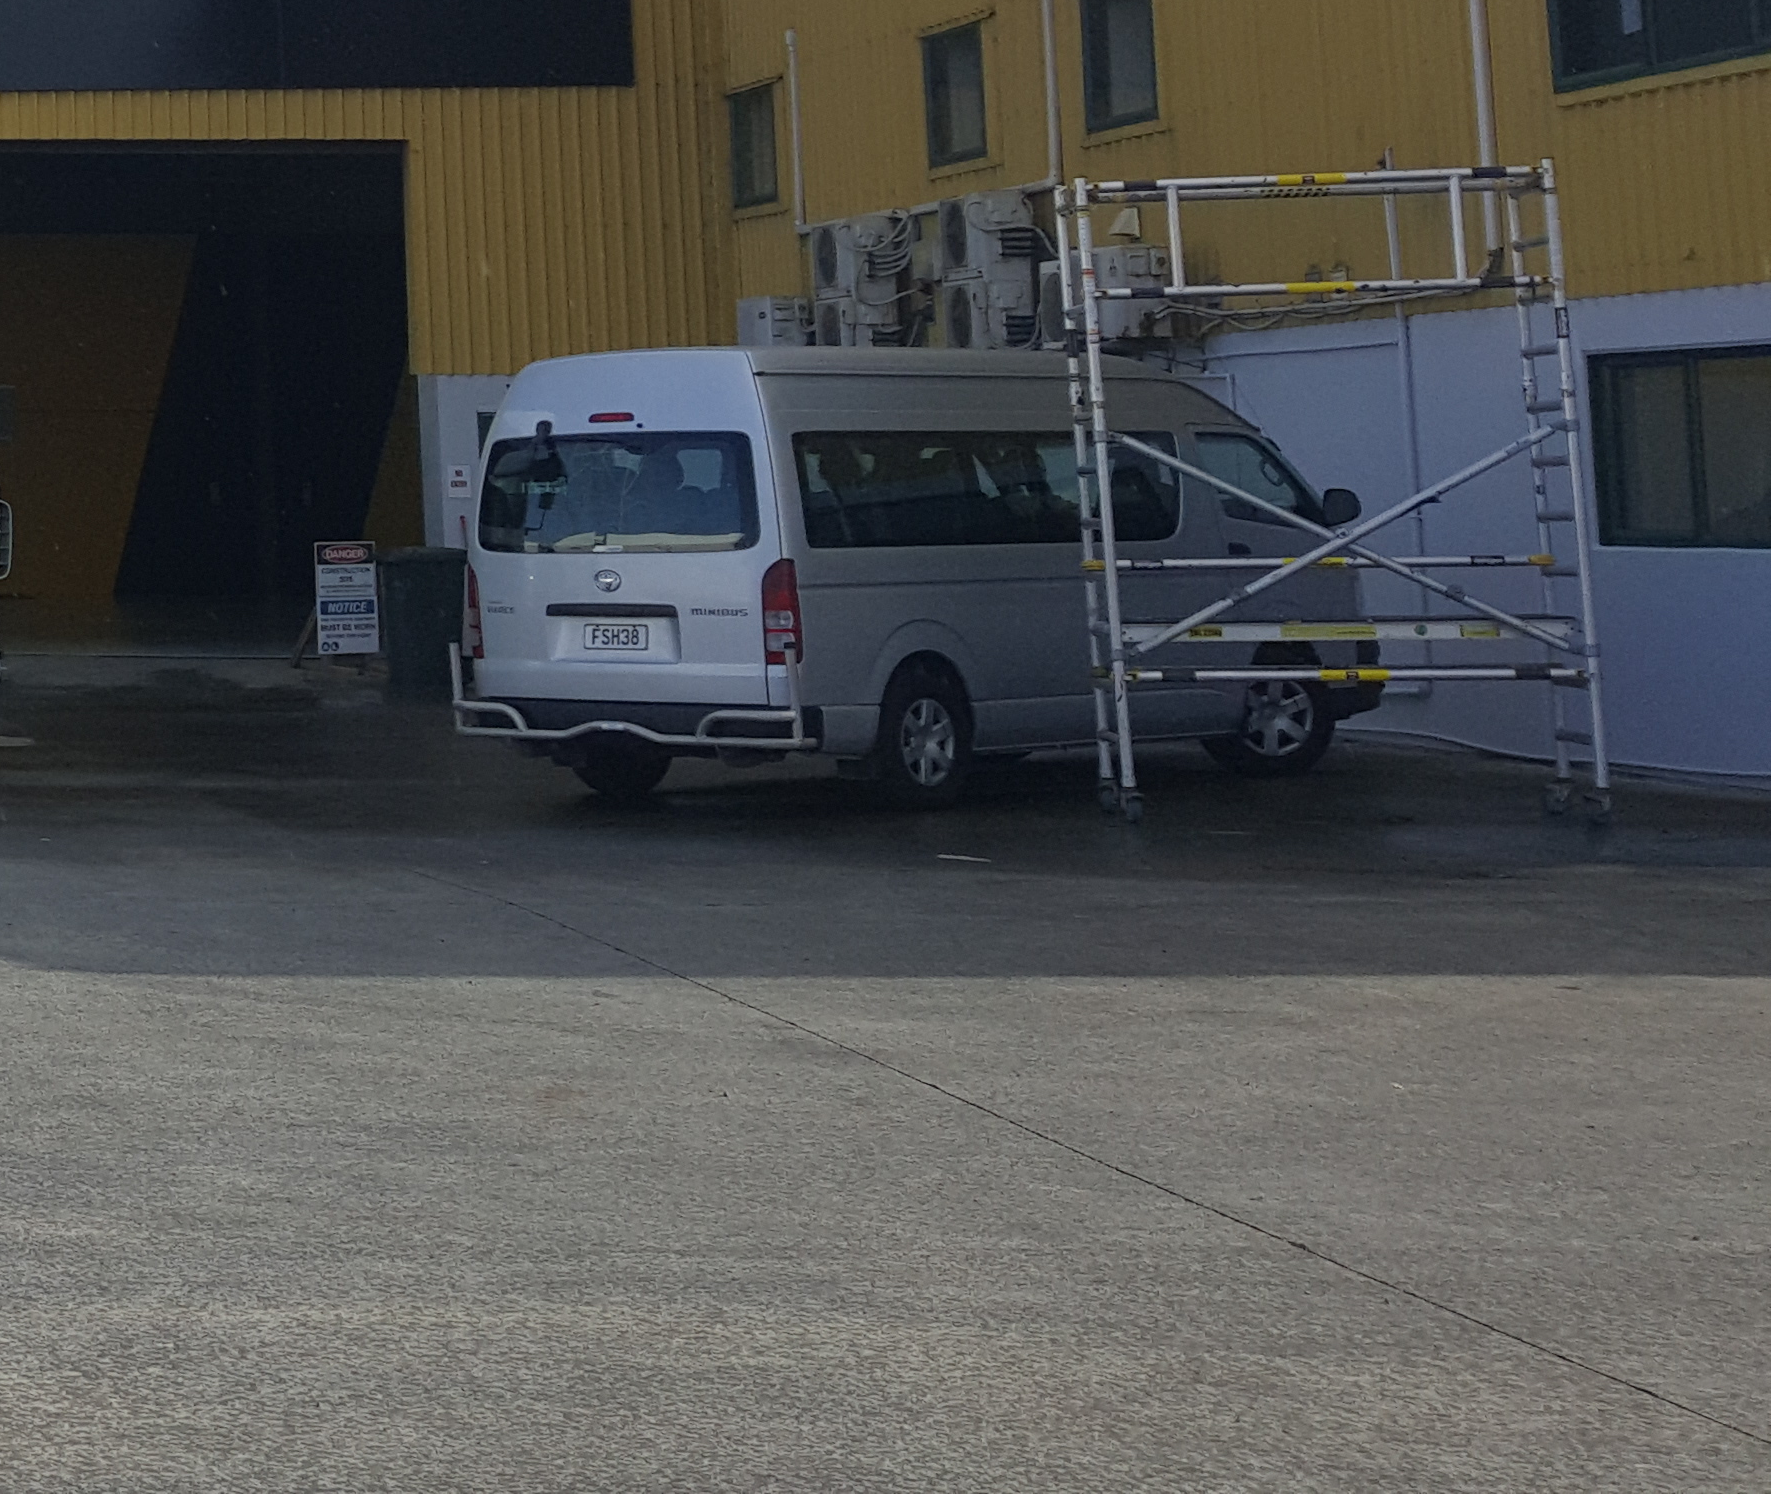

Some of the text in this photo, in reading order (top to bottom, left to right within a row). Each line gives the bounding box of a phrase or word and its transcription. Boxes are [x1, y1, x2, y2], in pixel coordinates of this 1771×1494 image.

[325, 549, 364, 559] DANGER
[327, 602, 367, 613] NOTICE
[691, 608, 749, 617] MINIBUS
[592, 628, 639, 645] FSH38
